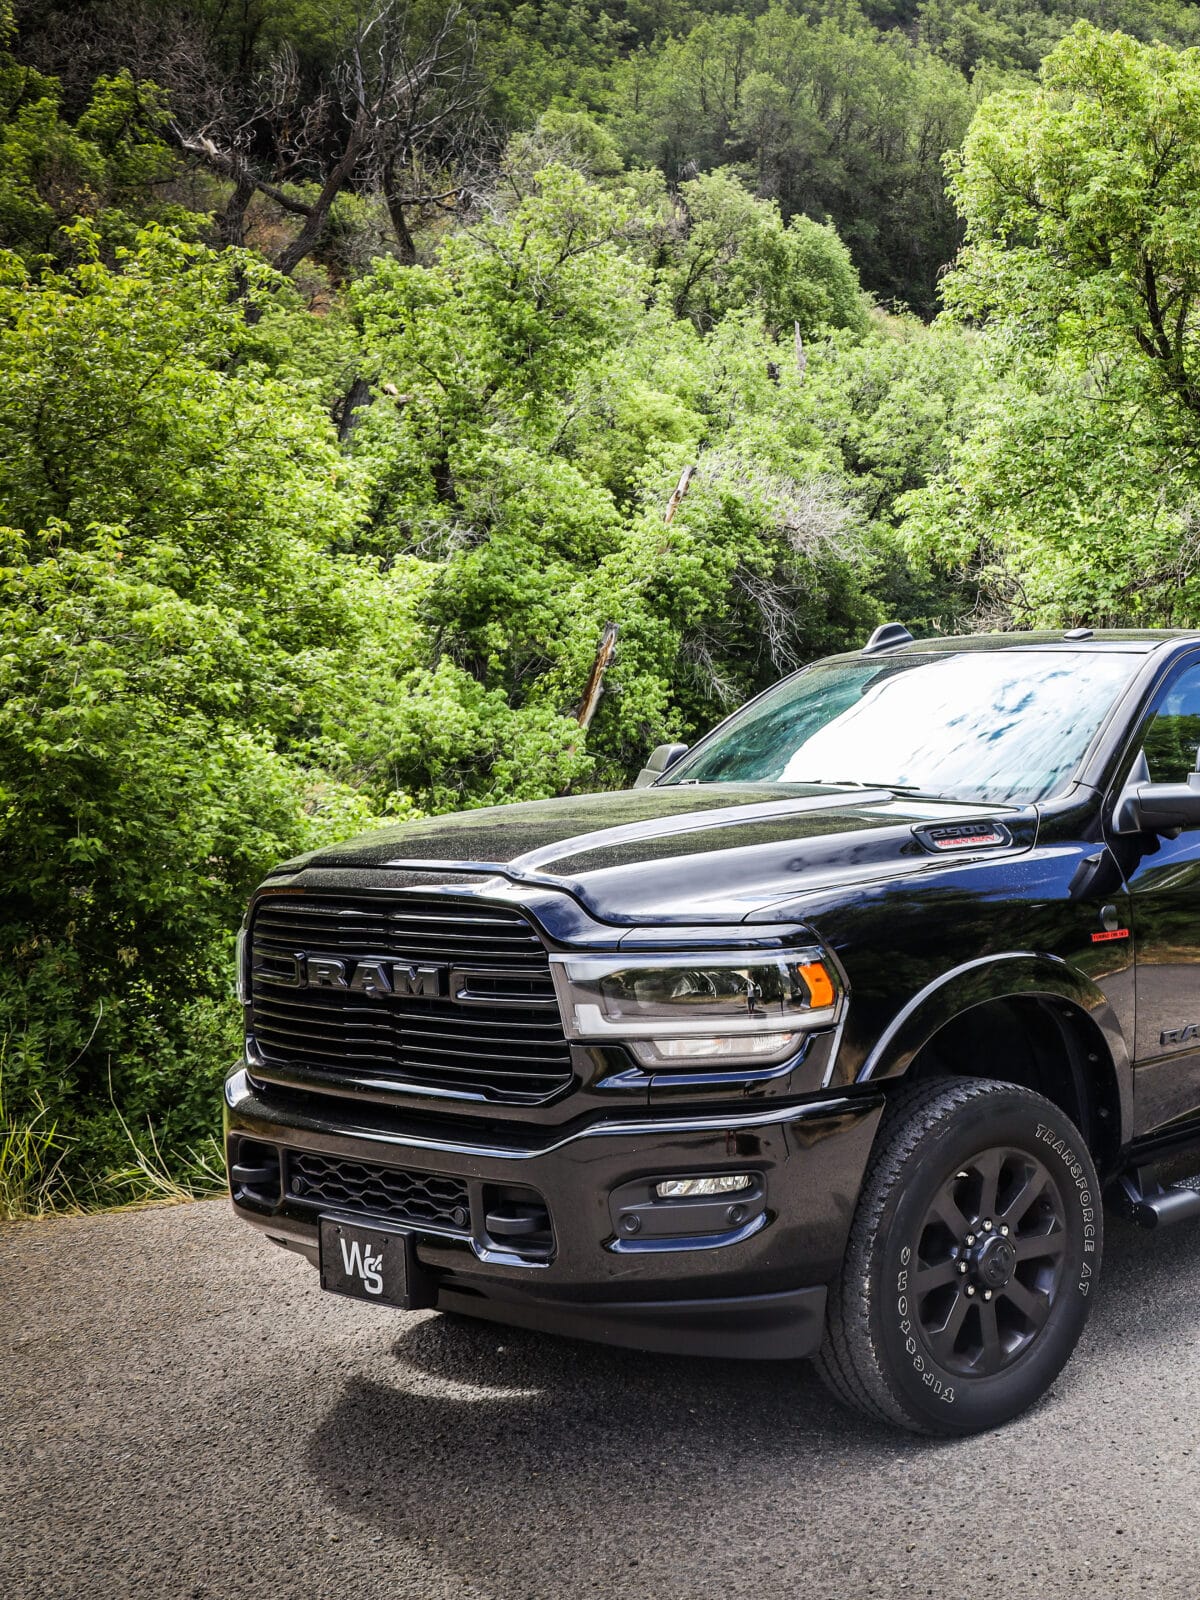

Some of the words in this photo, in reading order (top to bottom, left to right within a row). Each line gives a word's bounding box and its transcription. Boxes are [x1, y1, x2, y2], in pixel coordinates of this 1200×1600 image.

[929, 825, 988, 839] 2500
[307, 958, 440, 996] RAM
[1035, 1123, 1095, 1252] TRANSFORCE
[1079, 1262, 1092, 1296] AT
